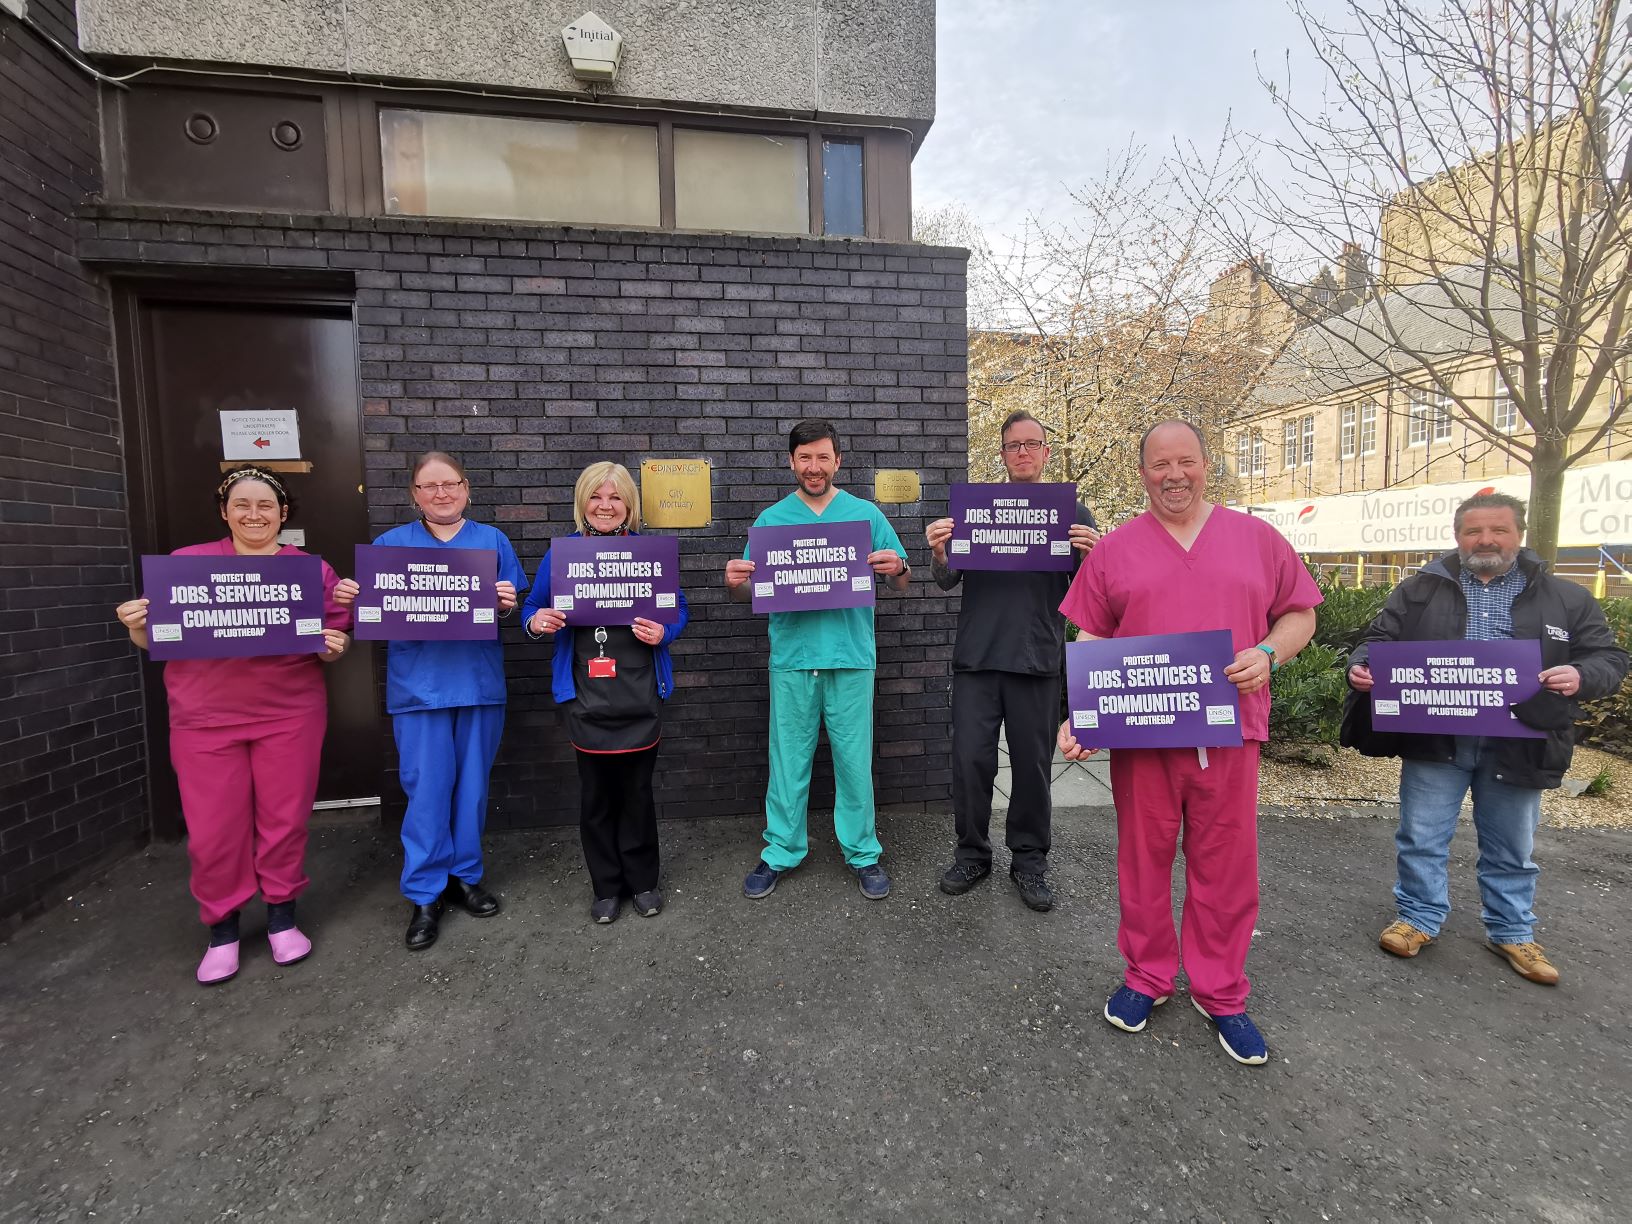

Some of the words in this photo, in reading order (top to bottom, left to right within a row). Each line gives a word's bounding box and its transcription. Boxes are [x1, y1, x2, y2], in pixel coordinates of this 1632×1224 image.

[580, 29, 614, 40] Initial
[669, 490, 683, 500] City
[660, 500, 694, 511] Mortuary
[964, 509, 993, 524] JOBS,
[995, 509, 1048, 524] SERVICES
[1050, 509, 1058, 524] &
[972, 529, 1048, 544] COMMUNITIES
[1361, 523, 1452, 544] Construc
[793, 539, 816, 547] PROTECT
[817, 538, 827, 546] OUR
[596, 552, 620, 560] PROTECT
[766, 550, 794, 565] JOBS,
[796, 547, 846, 564] SERVICES
[848, 546, 856, 560] &
[408, 564, 435, 572] PROTECT
[567, 563, 596, 578] JOBS,
[599, 562, 651, 578] SERVICES
[654, 562, 662, 576] &
[211, 574, 244, 583] PROTECT
[246, 573, 261, 582] OUR
[374, 573, 408, 591] JOBS,
[410, 575, 469, 590] SERVICES
[471, 576, 480, 591] &
[775, 567, 848, 585] COMMUNITIES
[170, 586, 212, 604] JOBS,
[216, 584, 288, 603] SERVICES
[291, 584, 303, 600] &
[575, 583, 652, 598] COMMUNITIES
[383, 596, 469, 612] COMMUNITIES
[183, 608, 290, 628] COMMUNITIES
[1123, 655, 1153, 666] PROTECT
[1155, 654, 1170, 664] OUR
[1427, 657, 1458, 666] PROTECT
[1459, 657, 1474, 666] OUR
[1088, 670, 1125, 689] JOBS,
[1127, 665, 1197, 687] SERVICES
[1200, 665, 1213, 683] &
[1390, 668, 1428, 685] JOBS,
[1431, 668, 1502, 685] SERVICES
[1505, 668, 1518, 685] &
[1098, 692, 1200, 714] COMMUNITIES
[1401, 689, 1504, 707] COMMUNITIES
[1427, 707, 1478, 717] #PLUGTHEGAP
[1125, 715, 1175, 726] #PLUGTHEGAP
